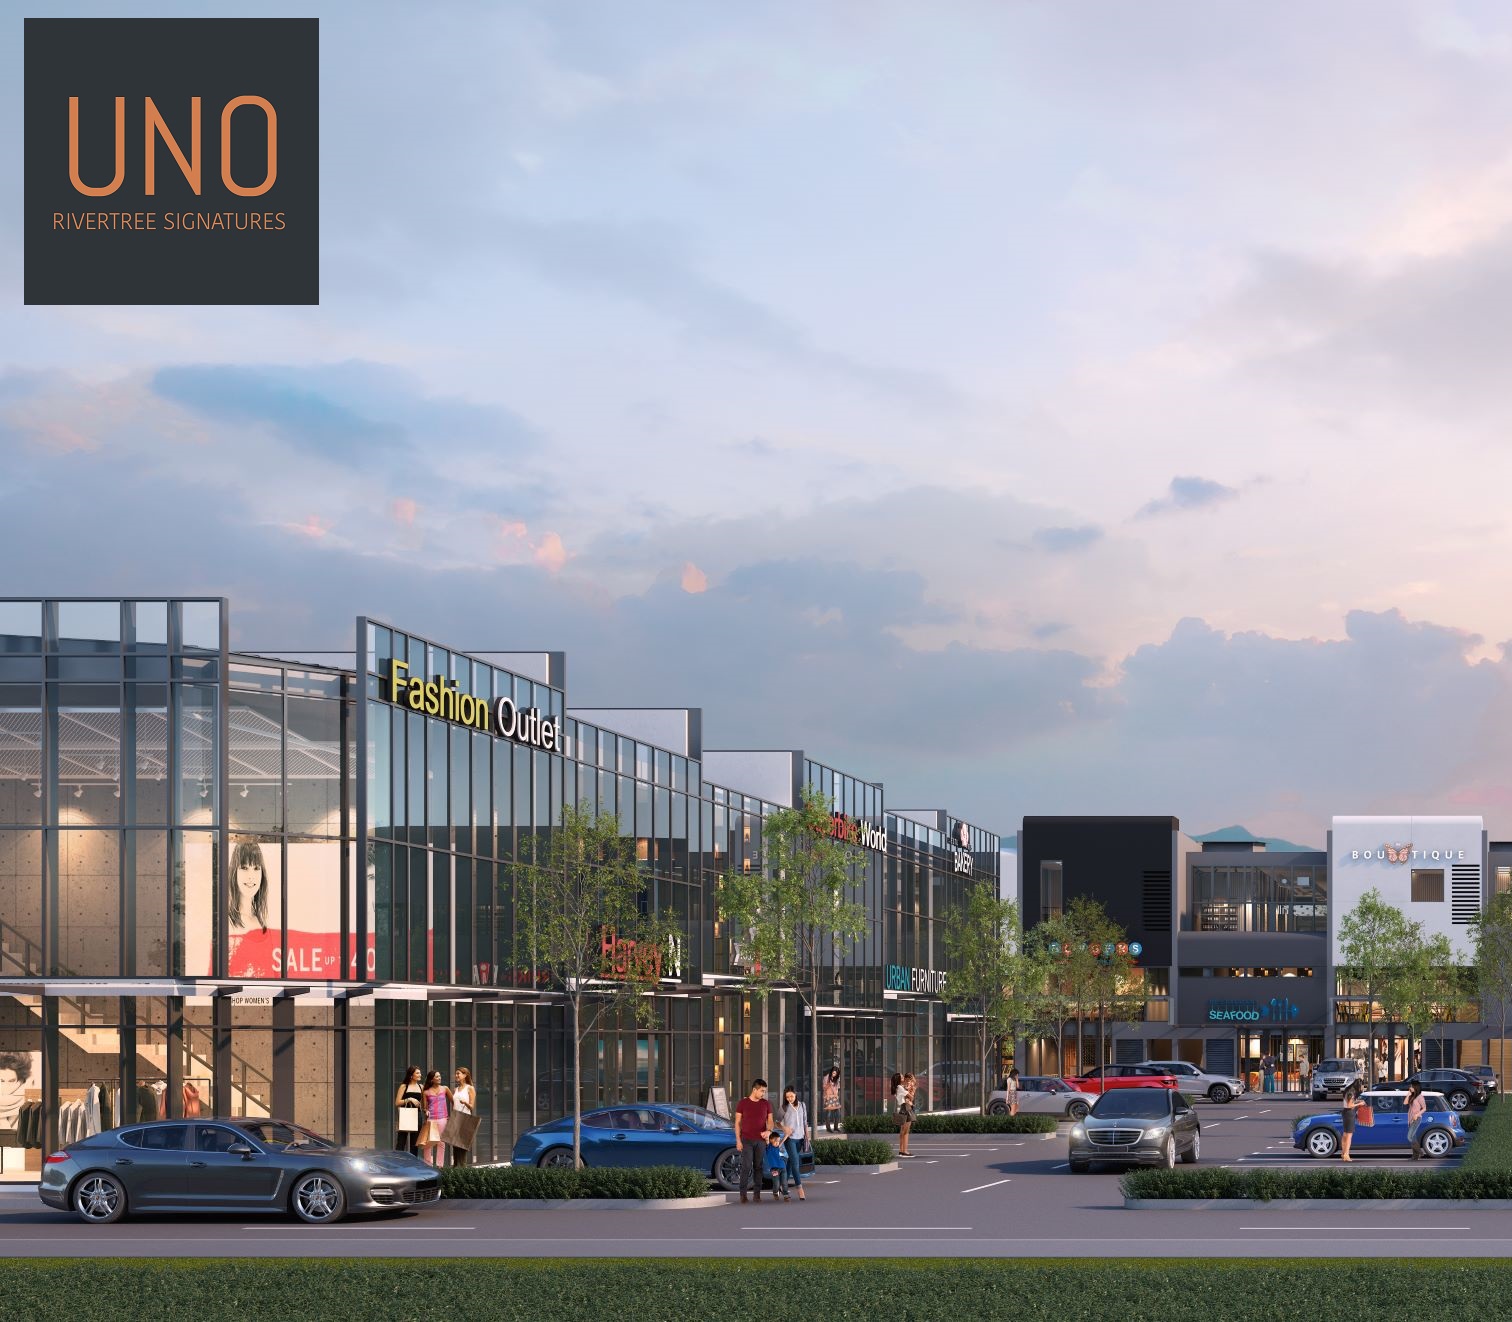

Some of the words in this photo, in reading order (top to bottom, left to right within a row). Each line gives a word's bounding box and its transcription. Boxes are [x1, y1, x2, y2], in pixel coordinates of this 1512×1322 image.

[391, 658, 489, 731] Fashion
[497, 696, 561, 752] Outlet
[860, 820, 888, 854] World
[271, 948, 323, 972] SALE
[324, 956, 336, 966] UP
[886, 964, 910, 991] URBAN
[1209, 1010, 1260, 1021] SEAFOOD
